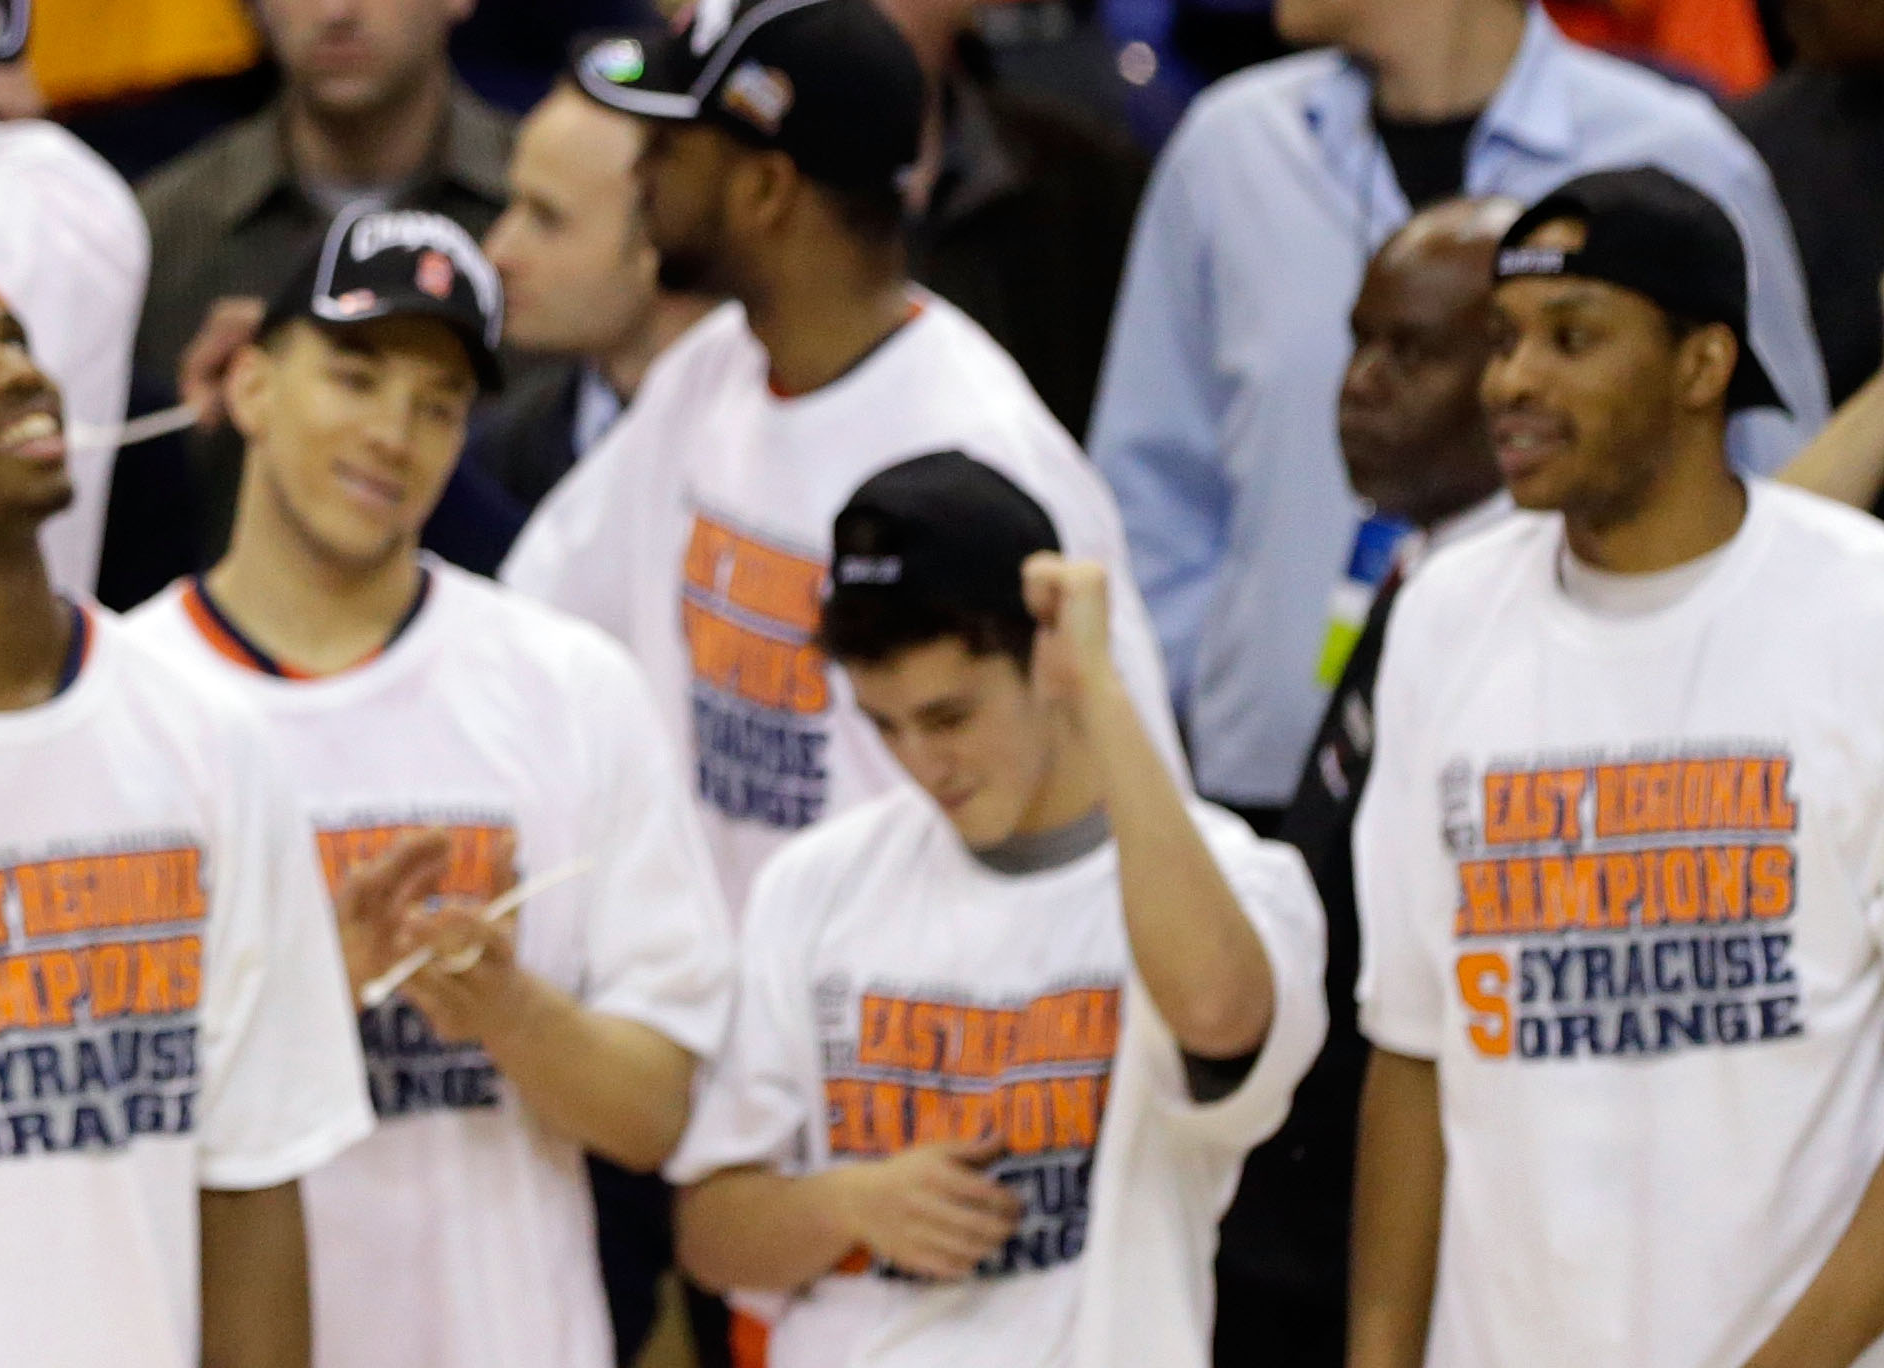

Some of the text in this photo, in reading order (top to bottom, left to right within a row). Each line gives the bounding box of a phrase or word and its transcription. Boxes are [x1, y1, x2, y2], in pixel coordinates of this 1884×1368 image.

[1484, 768, 1586, 845] EAST
[1456, 843, 1794, 936] HAMPIONS
[1456, 951, 1513, 1058] S
[1519, 933, 1795, 1002] SYRACUSE
[1519, 996, 1806, 1058] ORANGE
